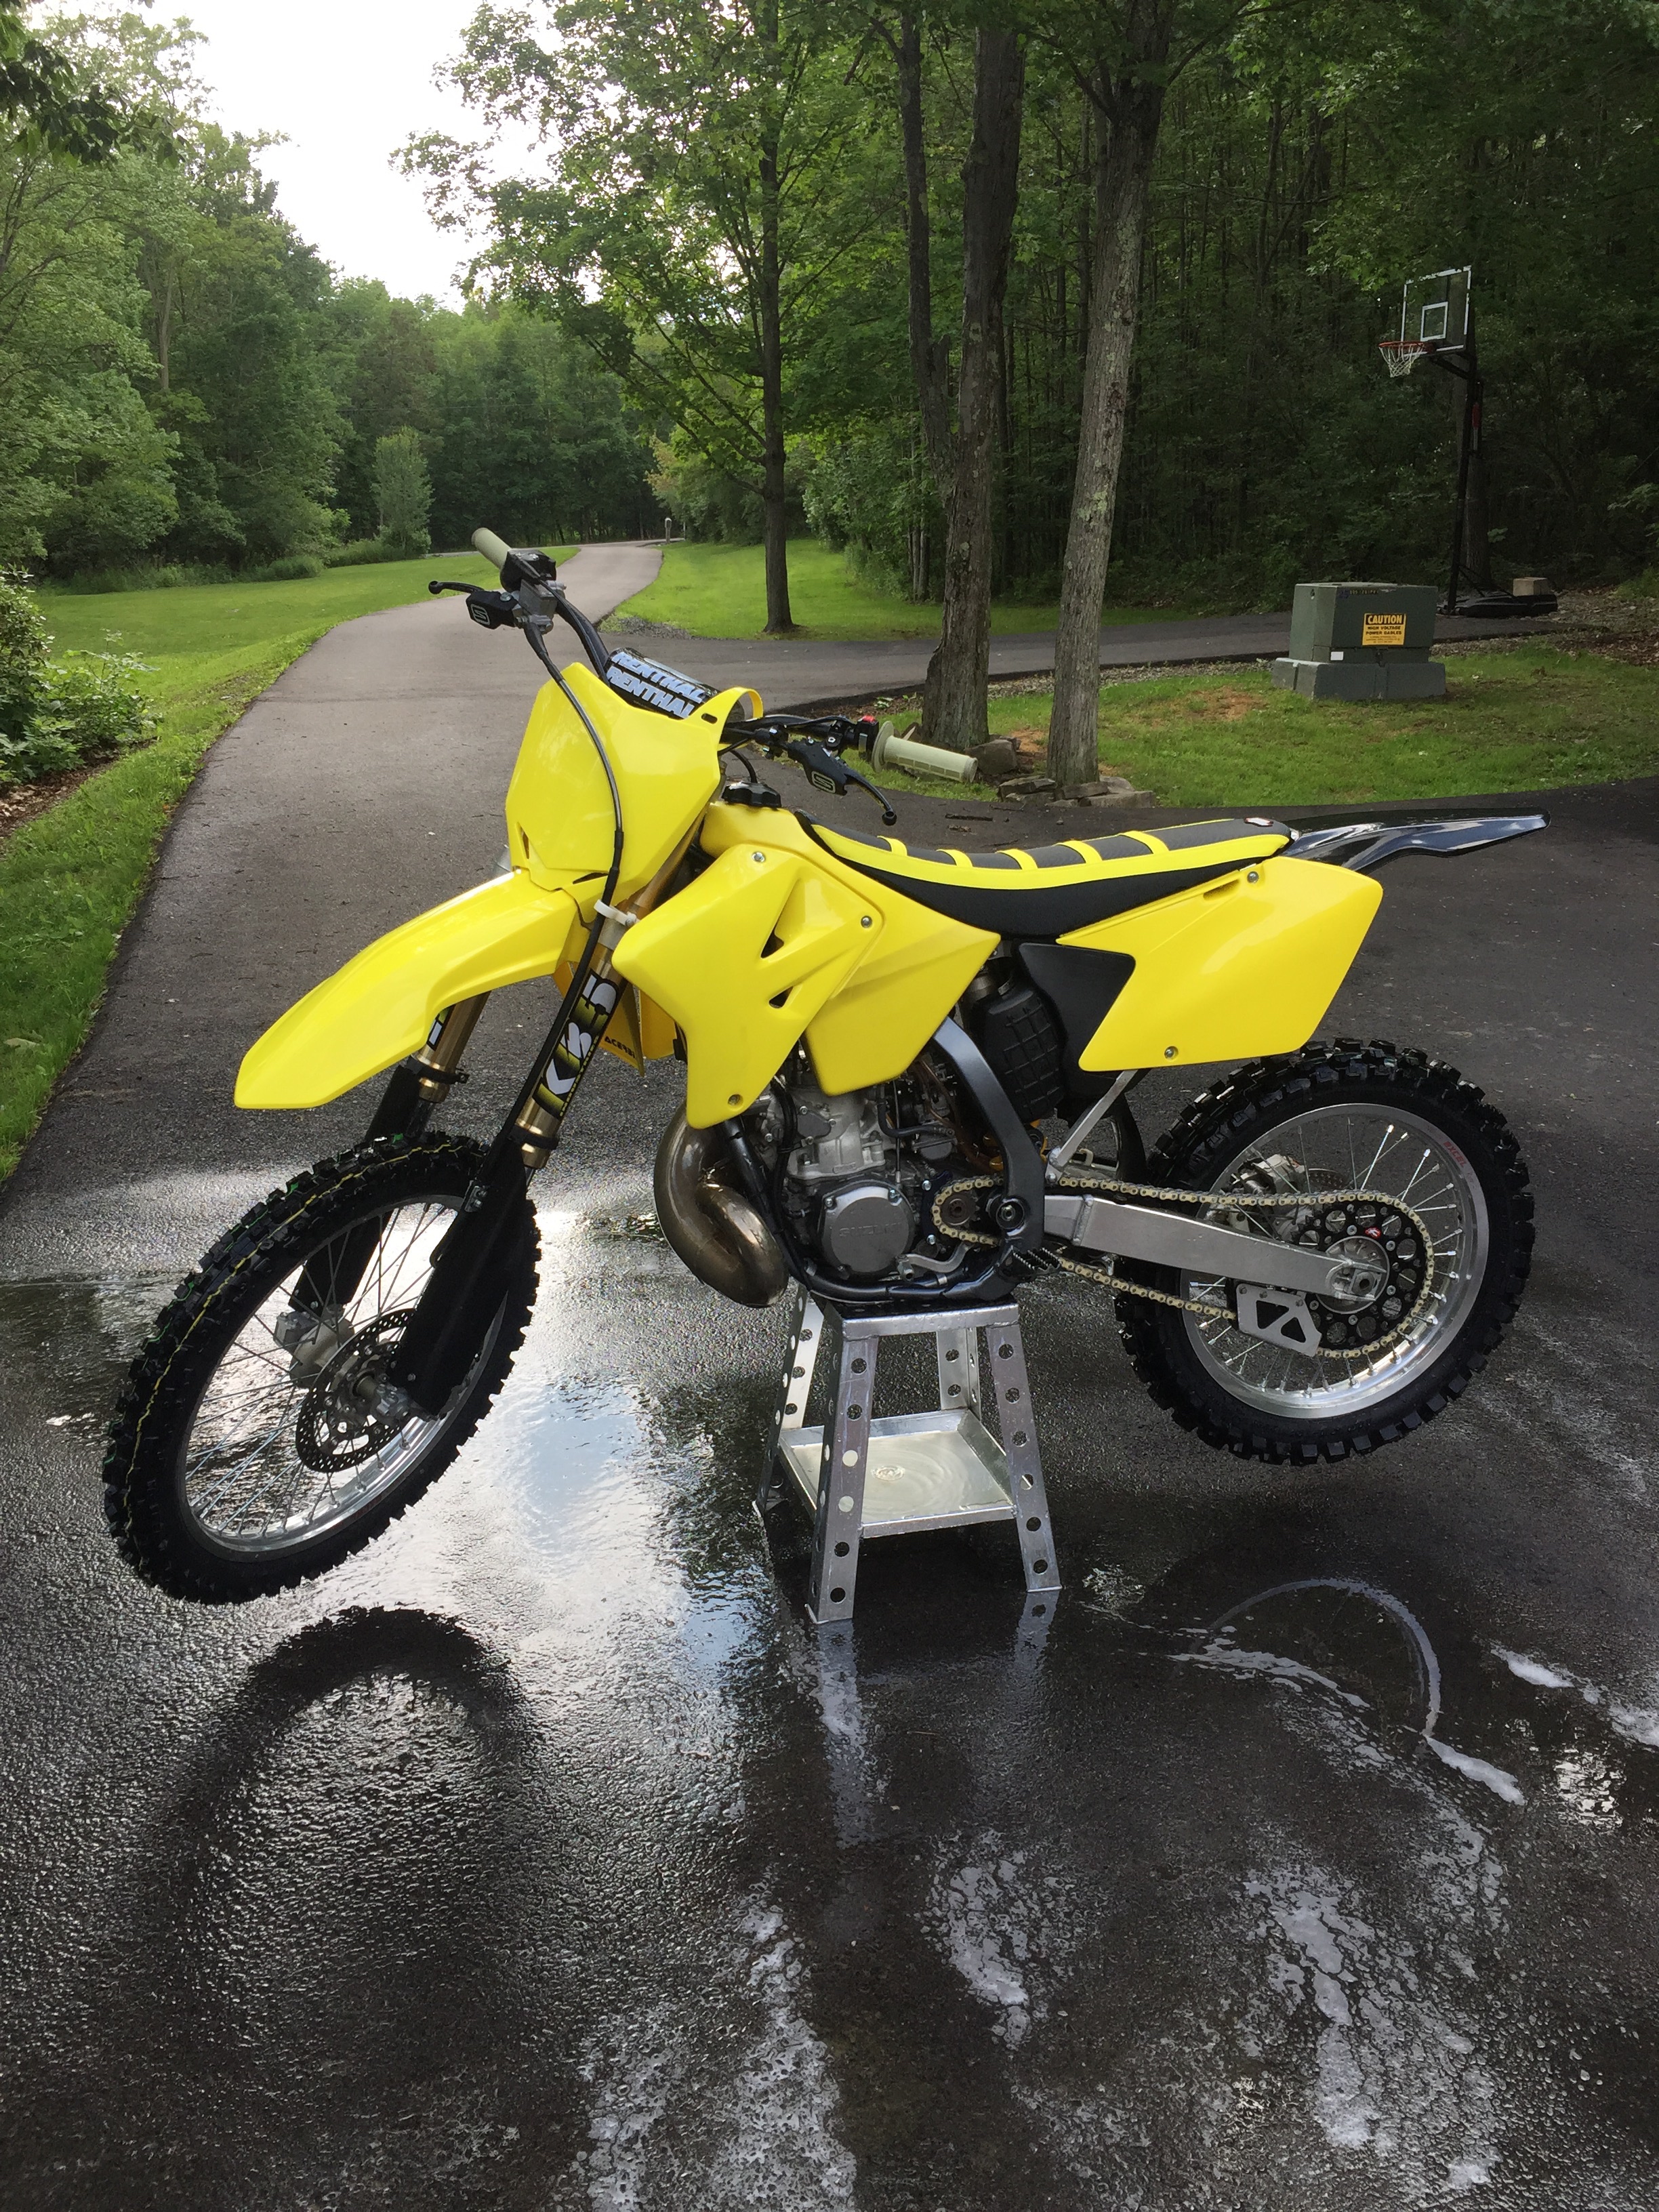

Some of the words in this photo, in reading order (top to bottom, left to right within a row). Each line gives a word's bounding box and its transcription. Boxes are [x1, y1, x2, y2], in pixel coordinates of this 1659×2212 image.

[1368, 615, 1402, 624] CAUTION
[606, 665, 695, 719] RENTHAL
[611, 651, 705, 704] RENTHAL
[1443, 1141, 1467, 1168] EXCEL
